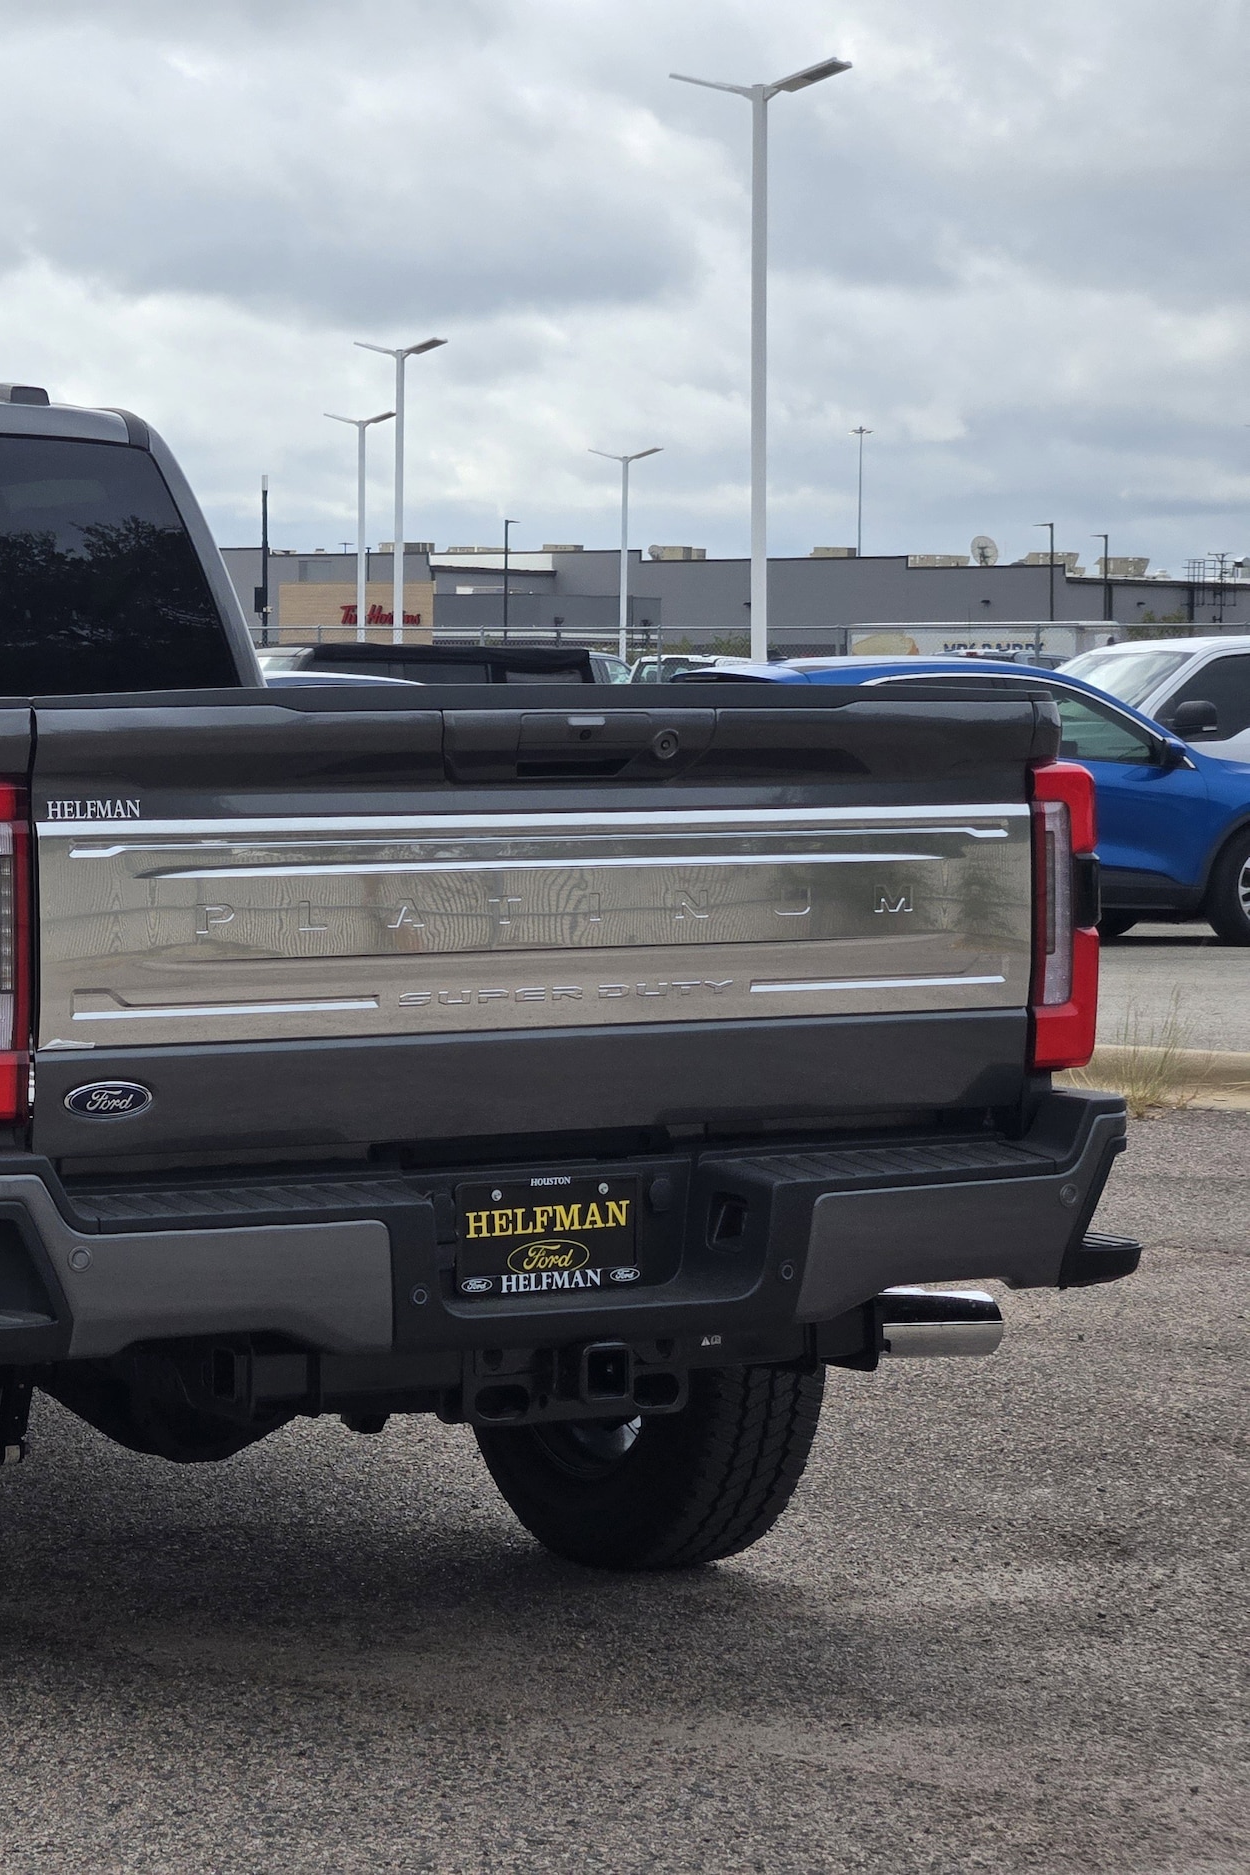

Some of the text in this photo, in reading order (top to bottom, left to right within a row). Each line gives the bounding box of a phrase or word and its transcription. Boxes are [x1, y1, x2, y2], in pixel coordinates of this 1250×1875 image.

[340, 604, 366, 624] Ti
[47, 799, 140, 820] HELFMAN
[196, 884, 913, 934] PLATINUM
[398, 978, 734, 1008] SUPER DUTY
[85, 1089, 134, 1111] Ford
[530, 1176, 571, 1187] HOUSTON
[465, 1199, 630, 1239] HELFMAN
[522, 1244, 575, 1270] Ford
[500, 1268, 602, 1294] HELFMAN
